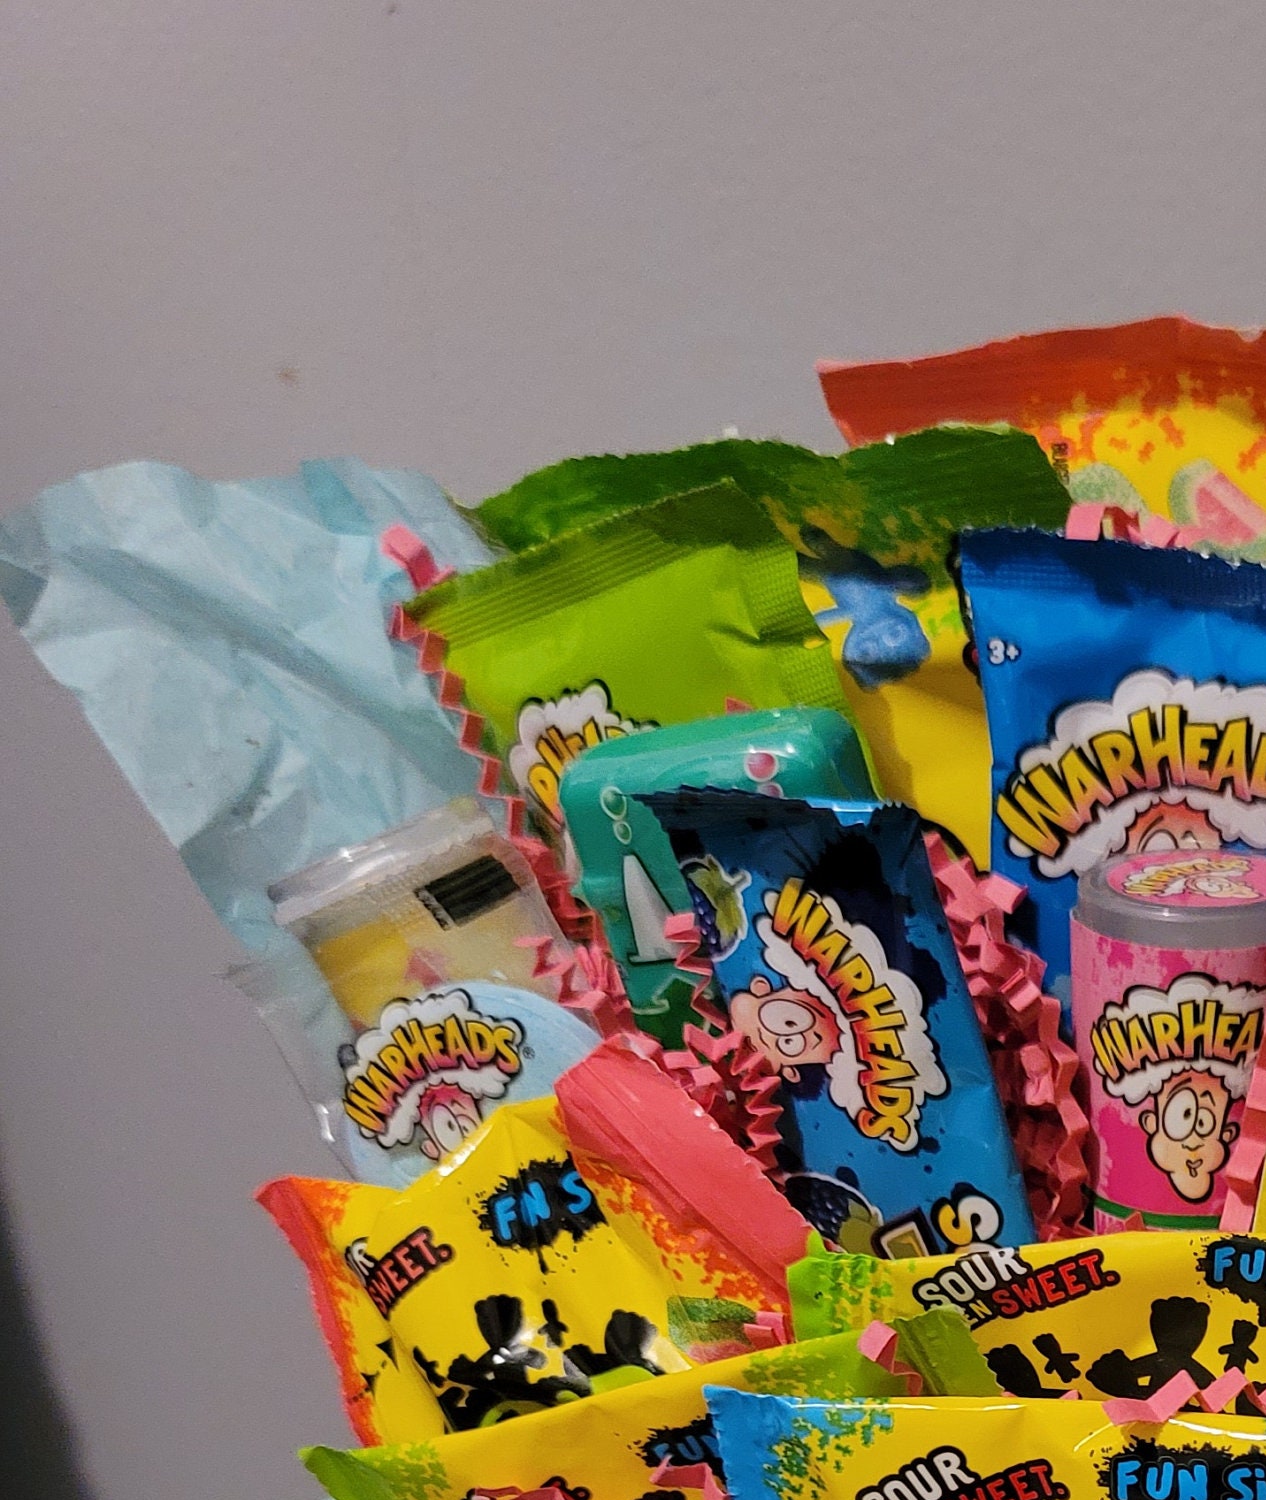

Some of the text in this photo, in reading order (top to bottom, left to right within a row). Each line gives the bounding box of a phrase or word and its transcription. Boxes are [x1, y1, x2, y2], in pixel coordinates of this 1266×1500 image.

[988, 638, 1020, 665] 3+
[772, 876, 914, 1147] WARHEADS
[1091, 999, 1264, 1082] WARHEA
[345, 1014, 522, 1134] WARHEADS
[917, 1246, 1028, 1308] SOUR
[991, 1252, 1117, 1316] SWEET.
